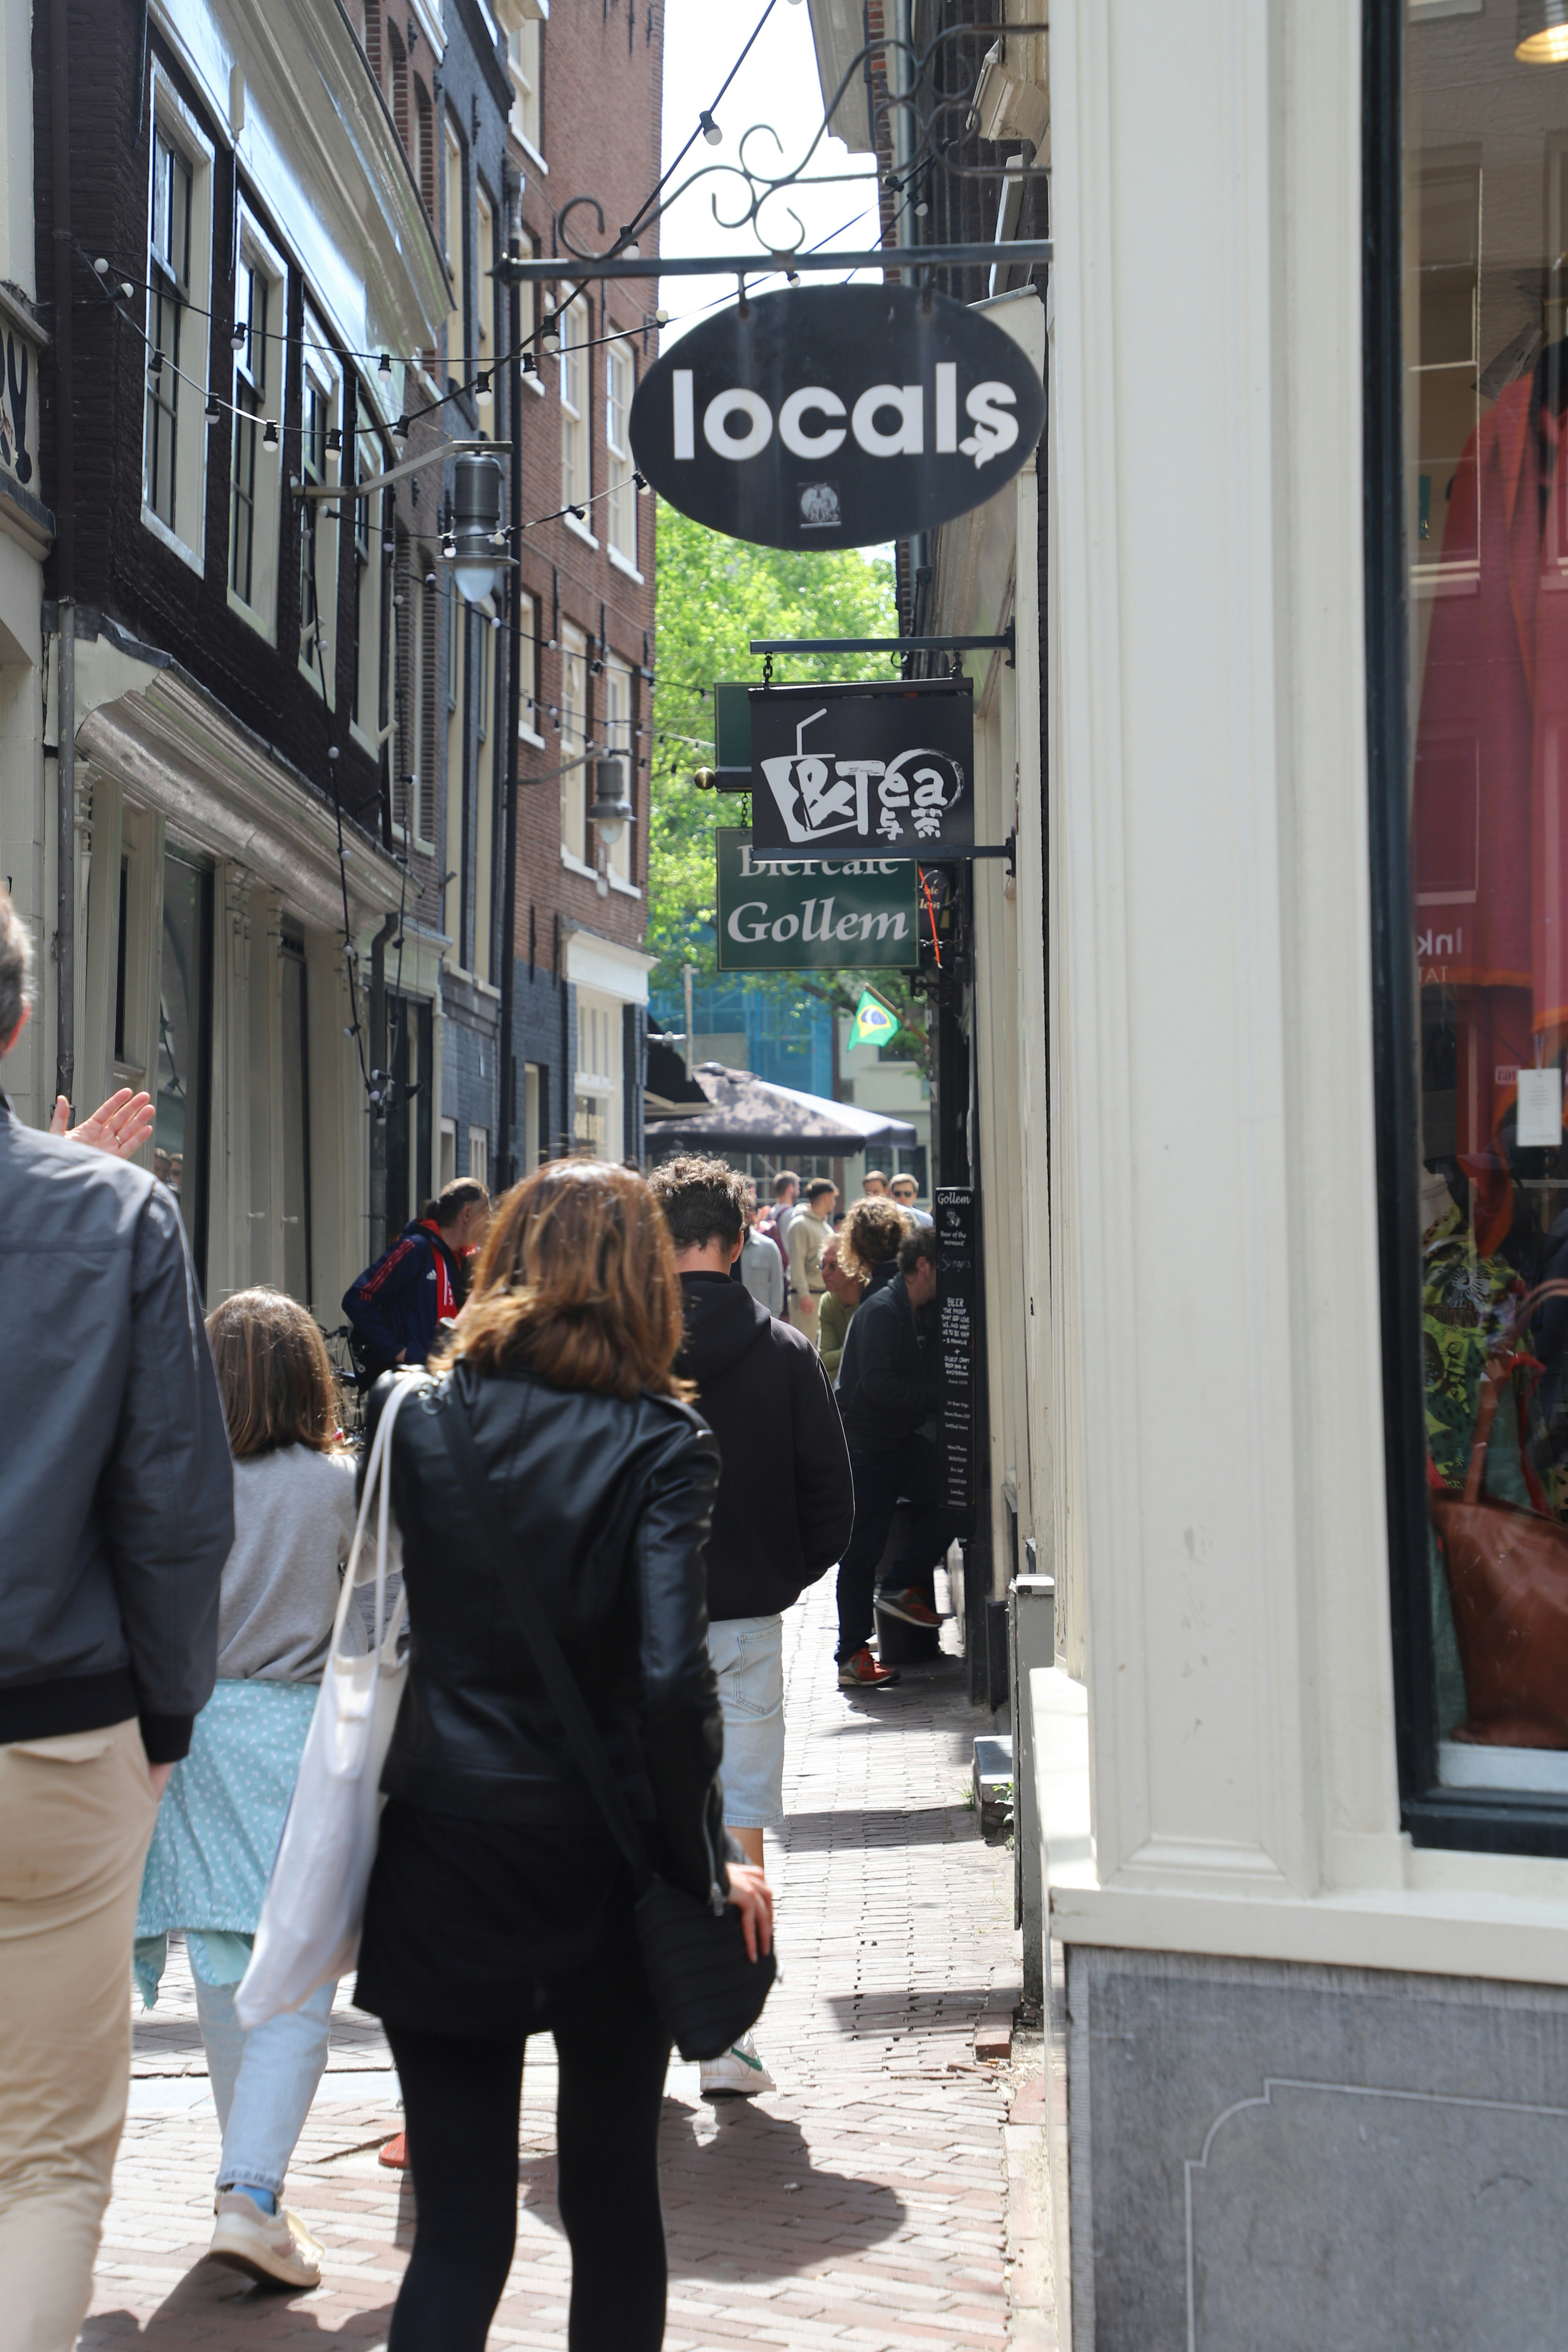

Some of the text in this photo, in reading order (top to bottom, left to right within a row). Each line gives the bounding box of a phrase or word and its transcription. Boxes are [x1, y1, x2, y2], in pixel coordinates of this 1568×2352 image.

[673, 362, 1018, 467] locals
[727, 897, 909, 943] Gollem
[938, 1192, 971, 1205] Gollem
[947, 1297, 964, 1308] BEER
